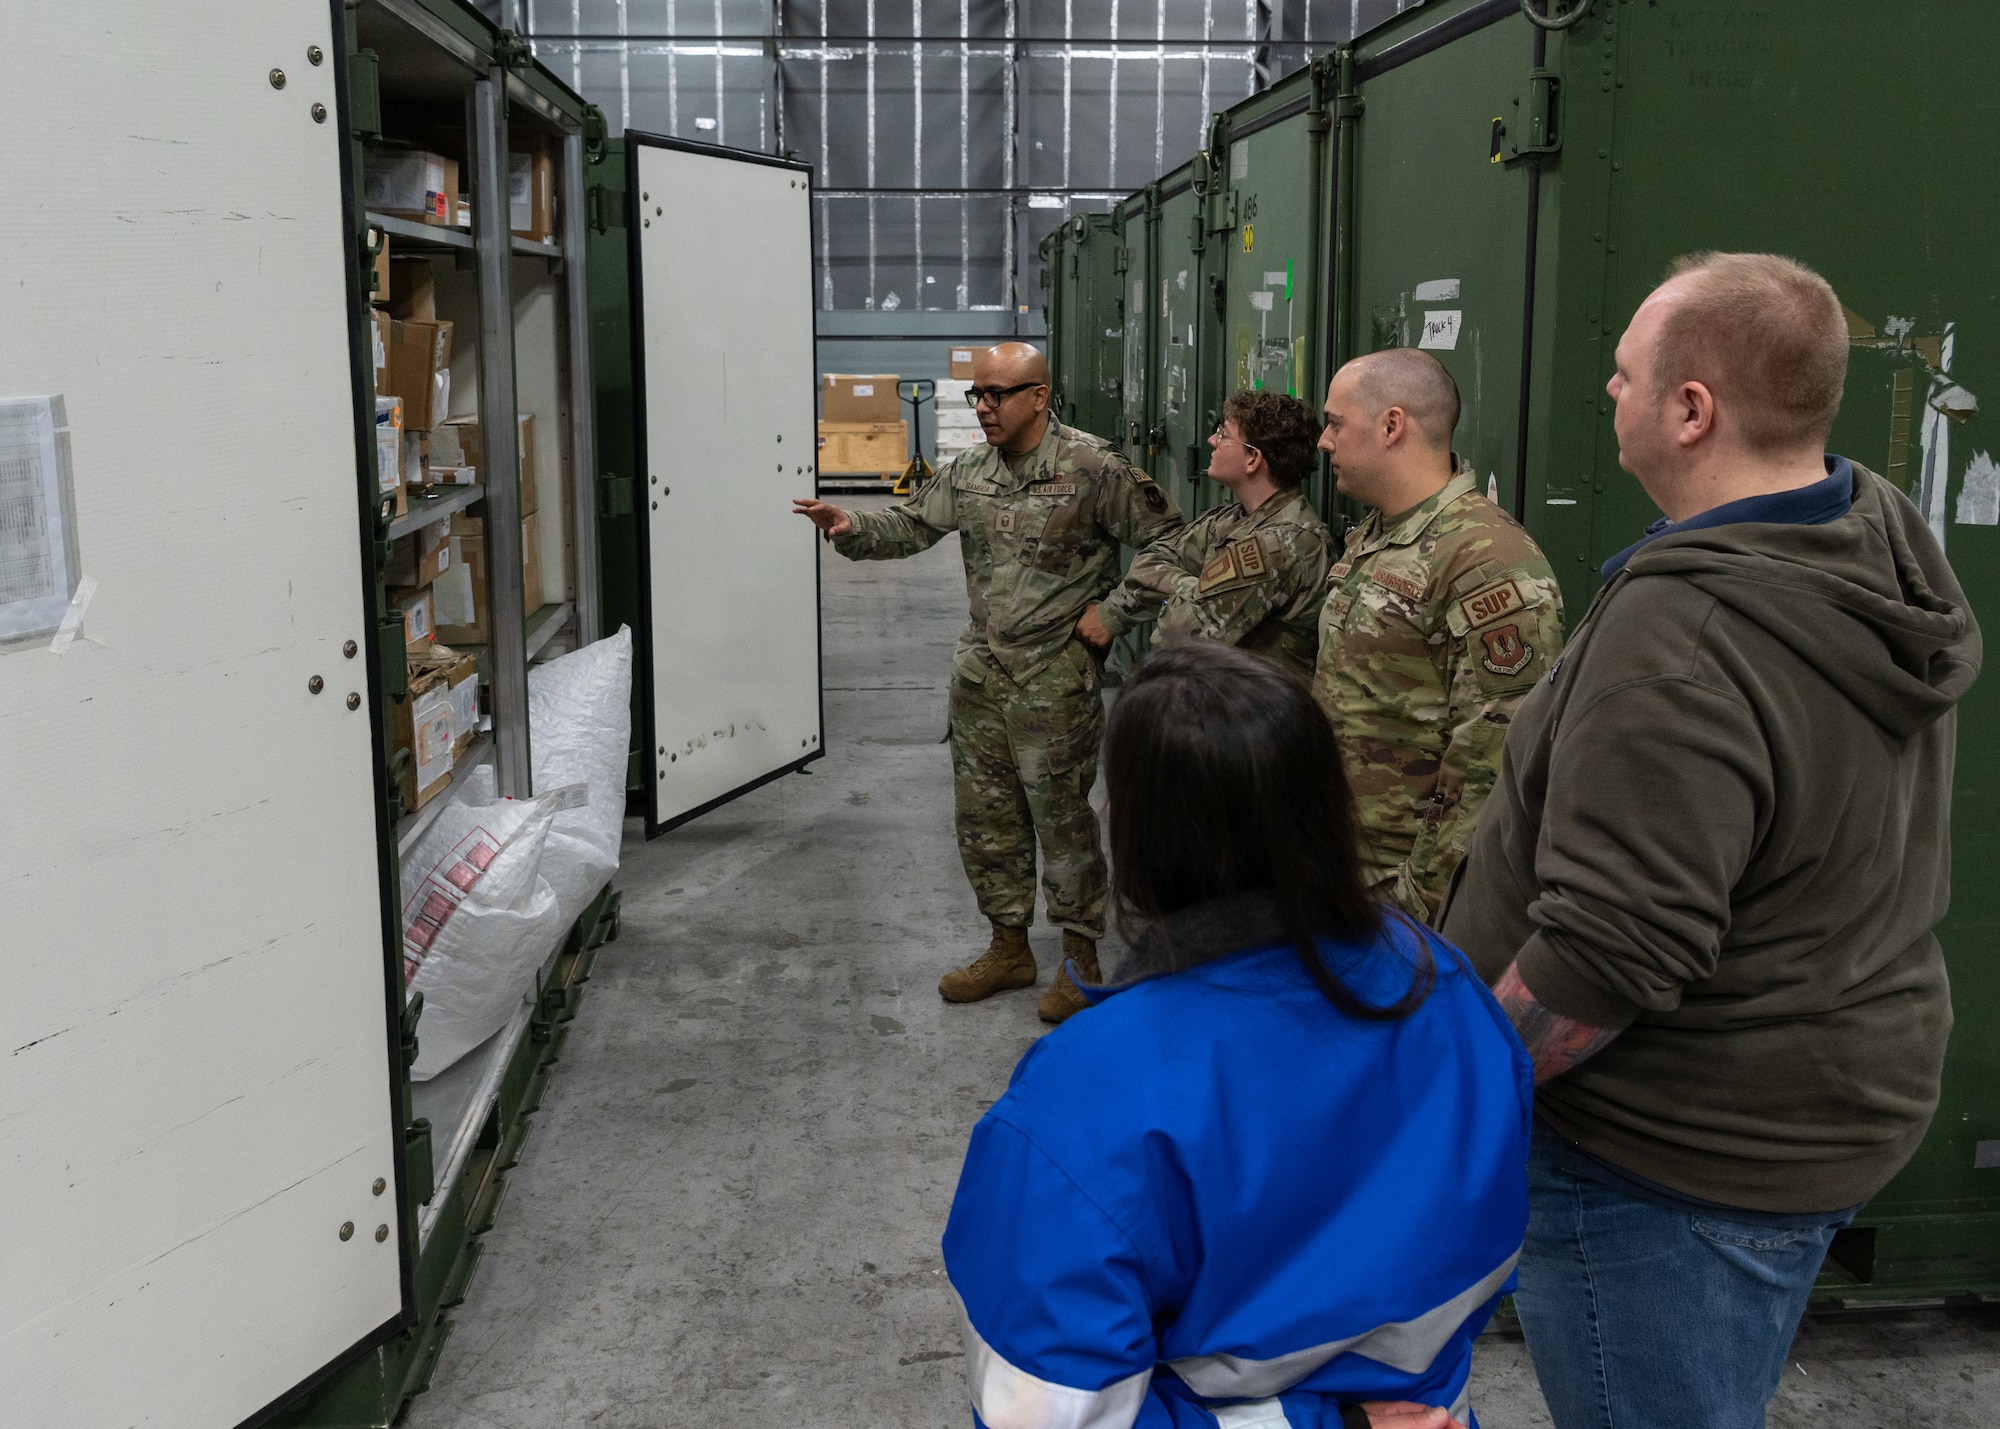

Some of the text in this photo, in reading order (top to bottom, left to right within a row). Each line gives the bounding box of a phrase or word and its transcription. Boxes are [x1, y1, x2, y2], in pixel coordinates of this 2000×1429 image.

[1243, 193, 1258, 222] 486
[1447, 315, 1454, 336] 4
[965, 482, 990, 493] GAMBOA
[1043, 484, 1053, 493] AIR
[1054, 484, 1072, 494] FORCE
[1241, 544, 1259, 569] SUP
[1393, 578, 1423, 599] FORCE
[1471, 587, 1511, 620] SUP
